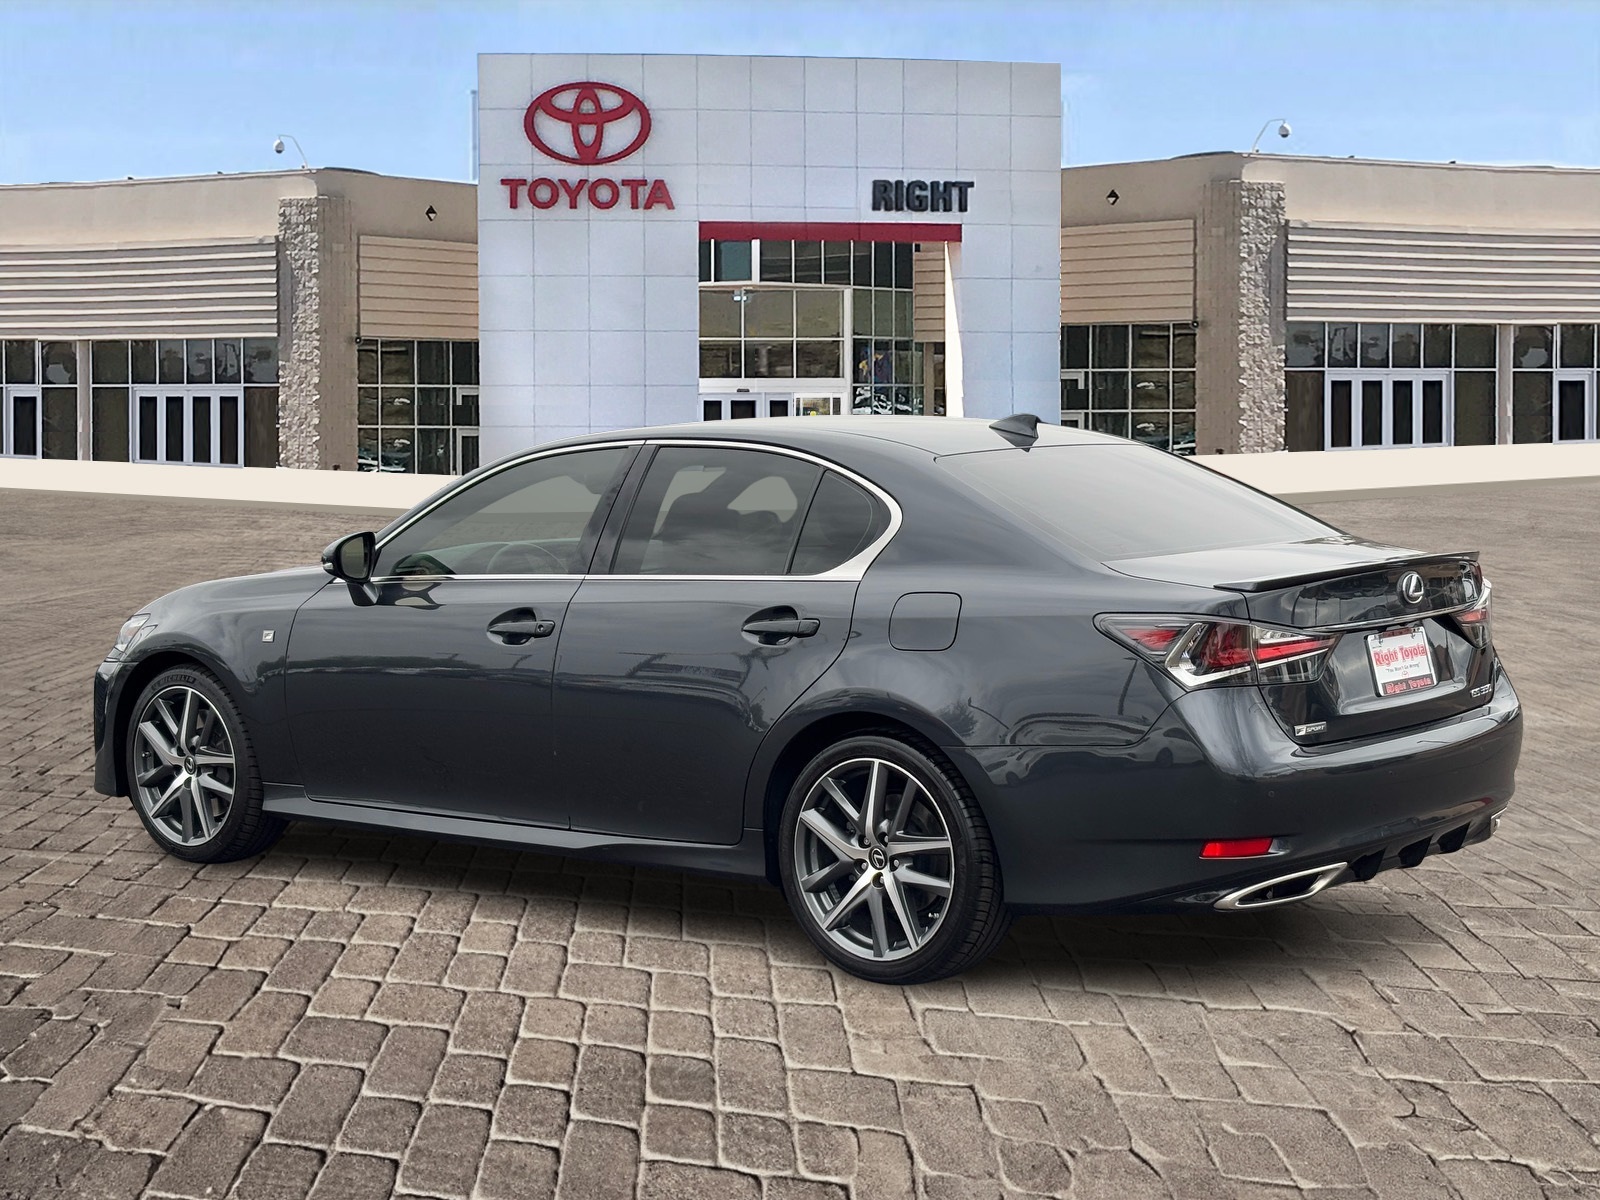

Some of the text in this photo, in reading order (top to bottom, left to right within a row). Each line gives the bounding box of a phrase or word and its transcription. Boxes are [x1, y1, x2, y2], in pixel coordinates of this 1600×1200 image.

[500, 178, 675, 210] TOYOTA
[872, 179, 975, 212] RIGHT
[1373, 645, 1426, 666] Right Toyota
[1306, 725, 1325, 733] SPORT
